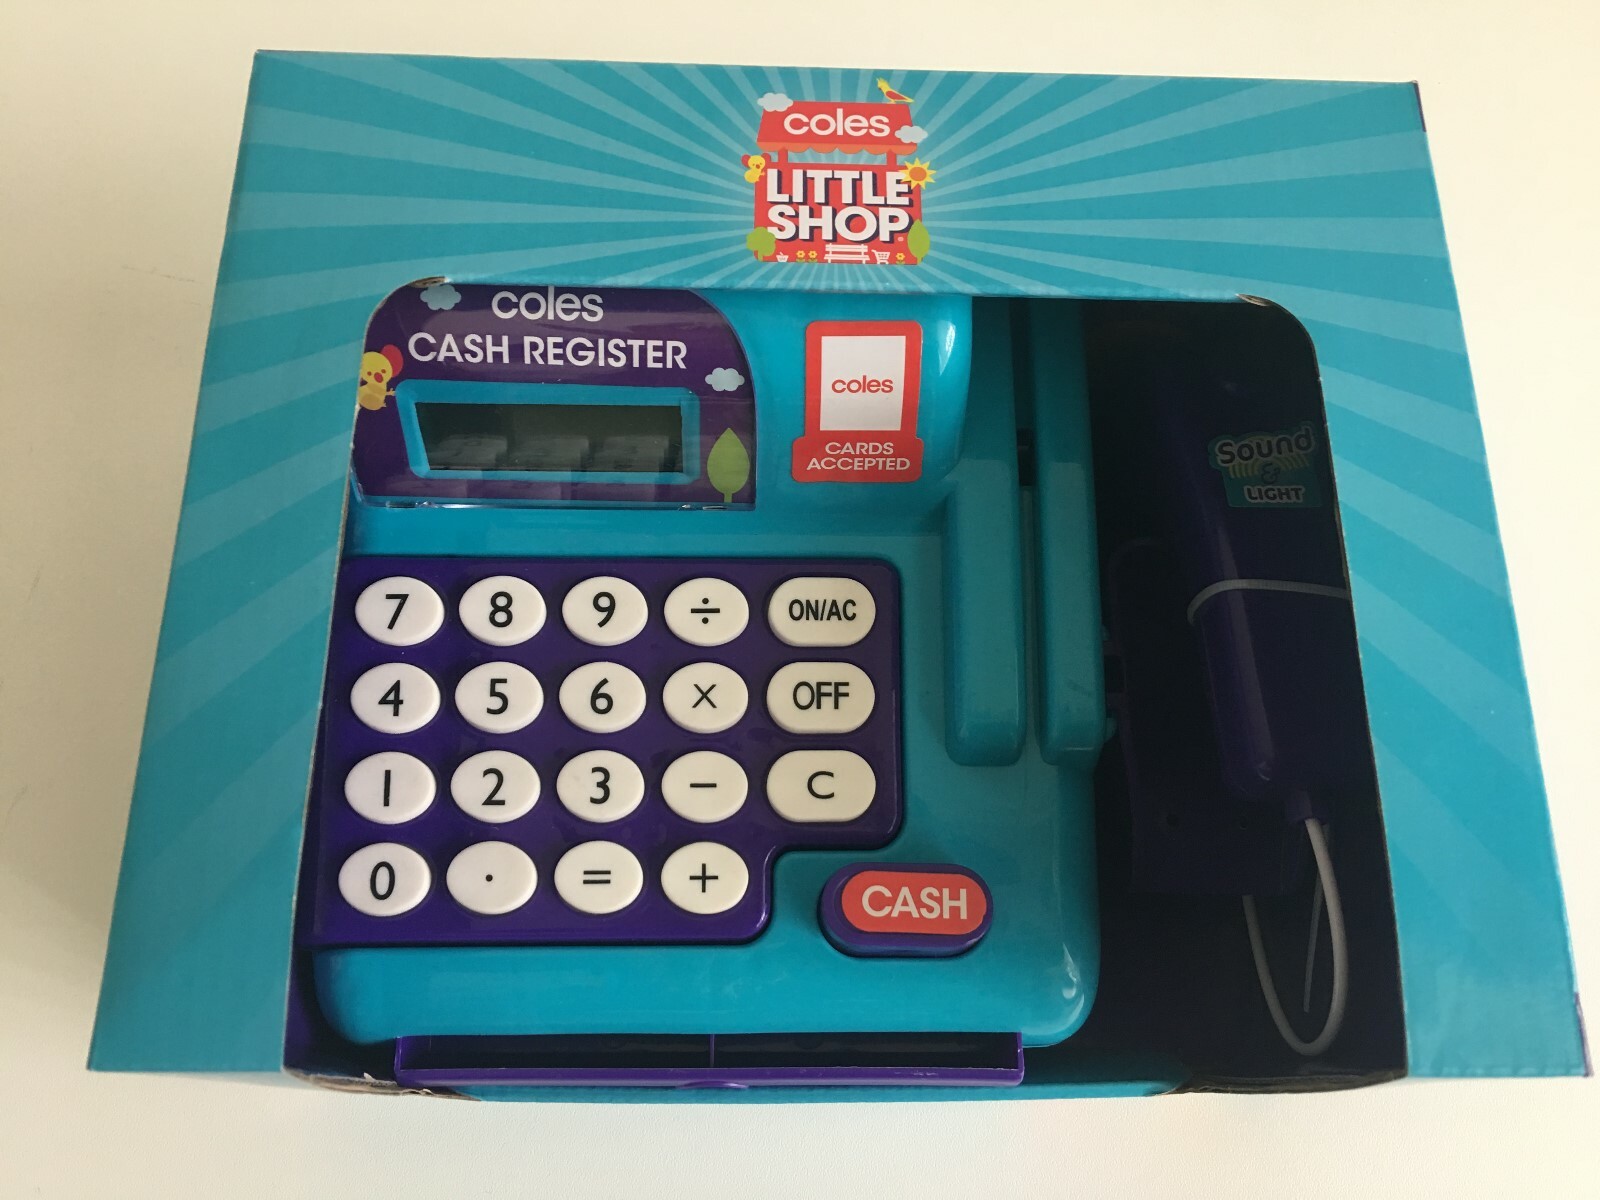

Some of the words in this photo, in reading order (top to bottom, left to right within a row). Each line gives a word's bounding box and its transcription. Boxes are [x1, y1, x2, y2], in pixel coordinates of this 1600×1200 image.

[784, 108, 890, 137] coles
[767, 168, 912, 207] LITTLE
[767, 204, 911, 242] SHOP
[491, 286, 604, 322] coles
[408, 332, 509, 364] CASH
[523, 336, 687, 369] REGISTER
[831, 375, 894, 394] coles
[806, 457, 911, 471] ACCEPTED
[825, 442, 894, 455] CARDS
[1216, 426, 1314, 466] Sound
[1260, 462, 1281, 485] &
[1246, 487, 1303, 501] LIGHT
[385, 593, 410, 630] 7
[489, 591, 513, 628] 8
[592, 591, 616, 628] 9
[788, 598, 857, 622] ON/AC
[378, 679, 404, 717] 4
[486, 678, 509, 715] 5
[590, 677, 614, 715] 6
[792, 680, 850, 711] OFF
[481, 767, 506, 806] 2
[589, 766, 611, 804] 3
[806, 770, 835, 800] C
[369, 860, 396, 901] 0
[861, 884, 968, 920] CASH
